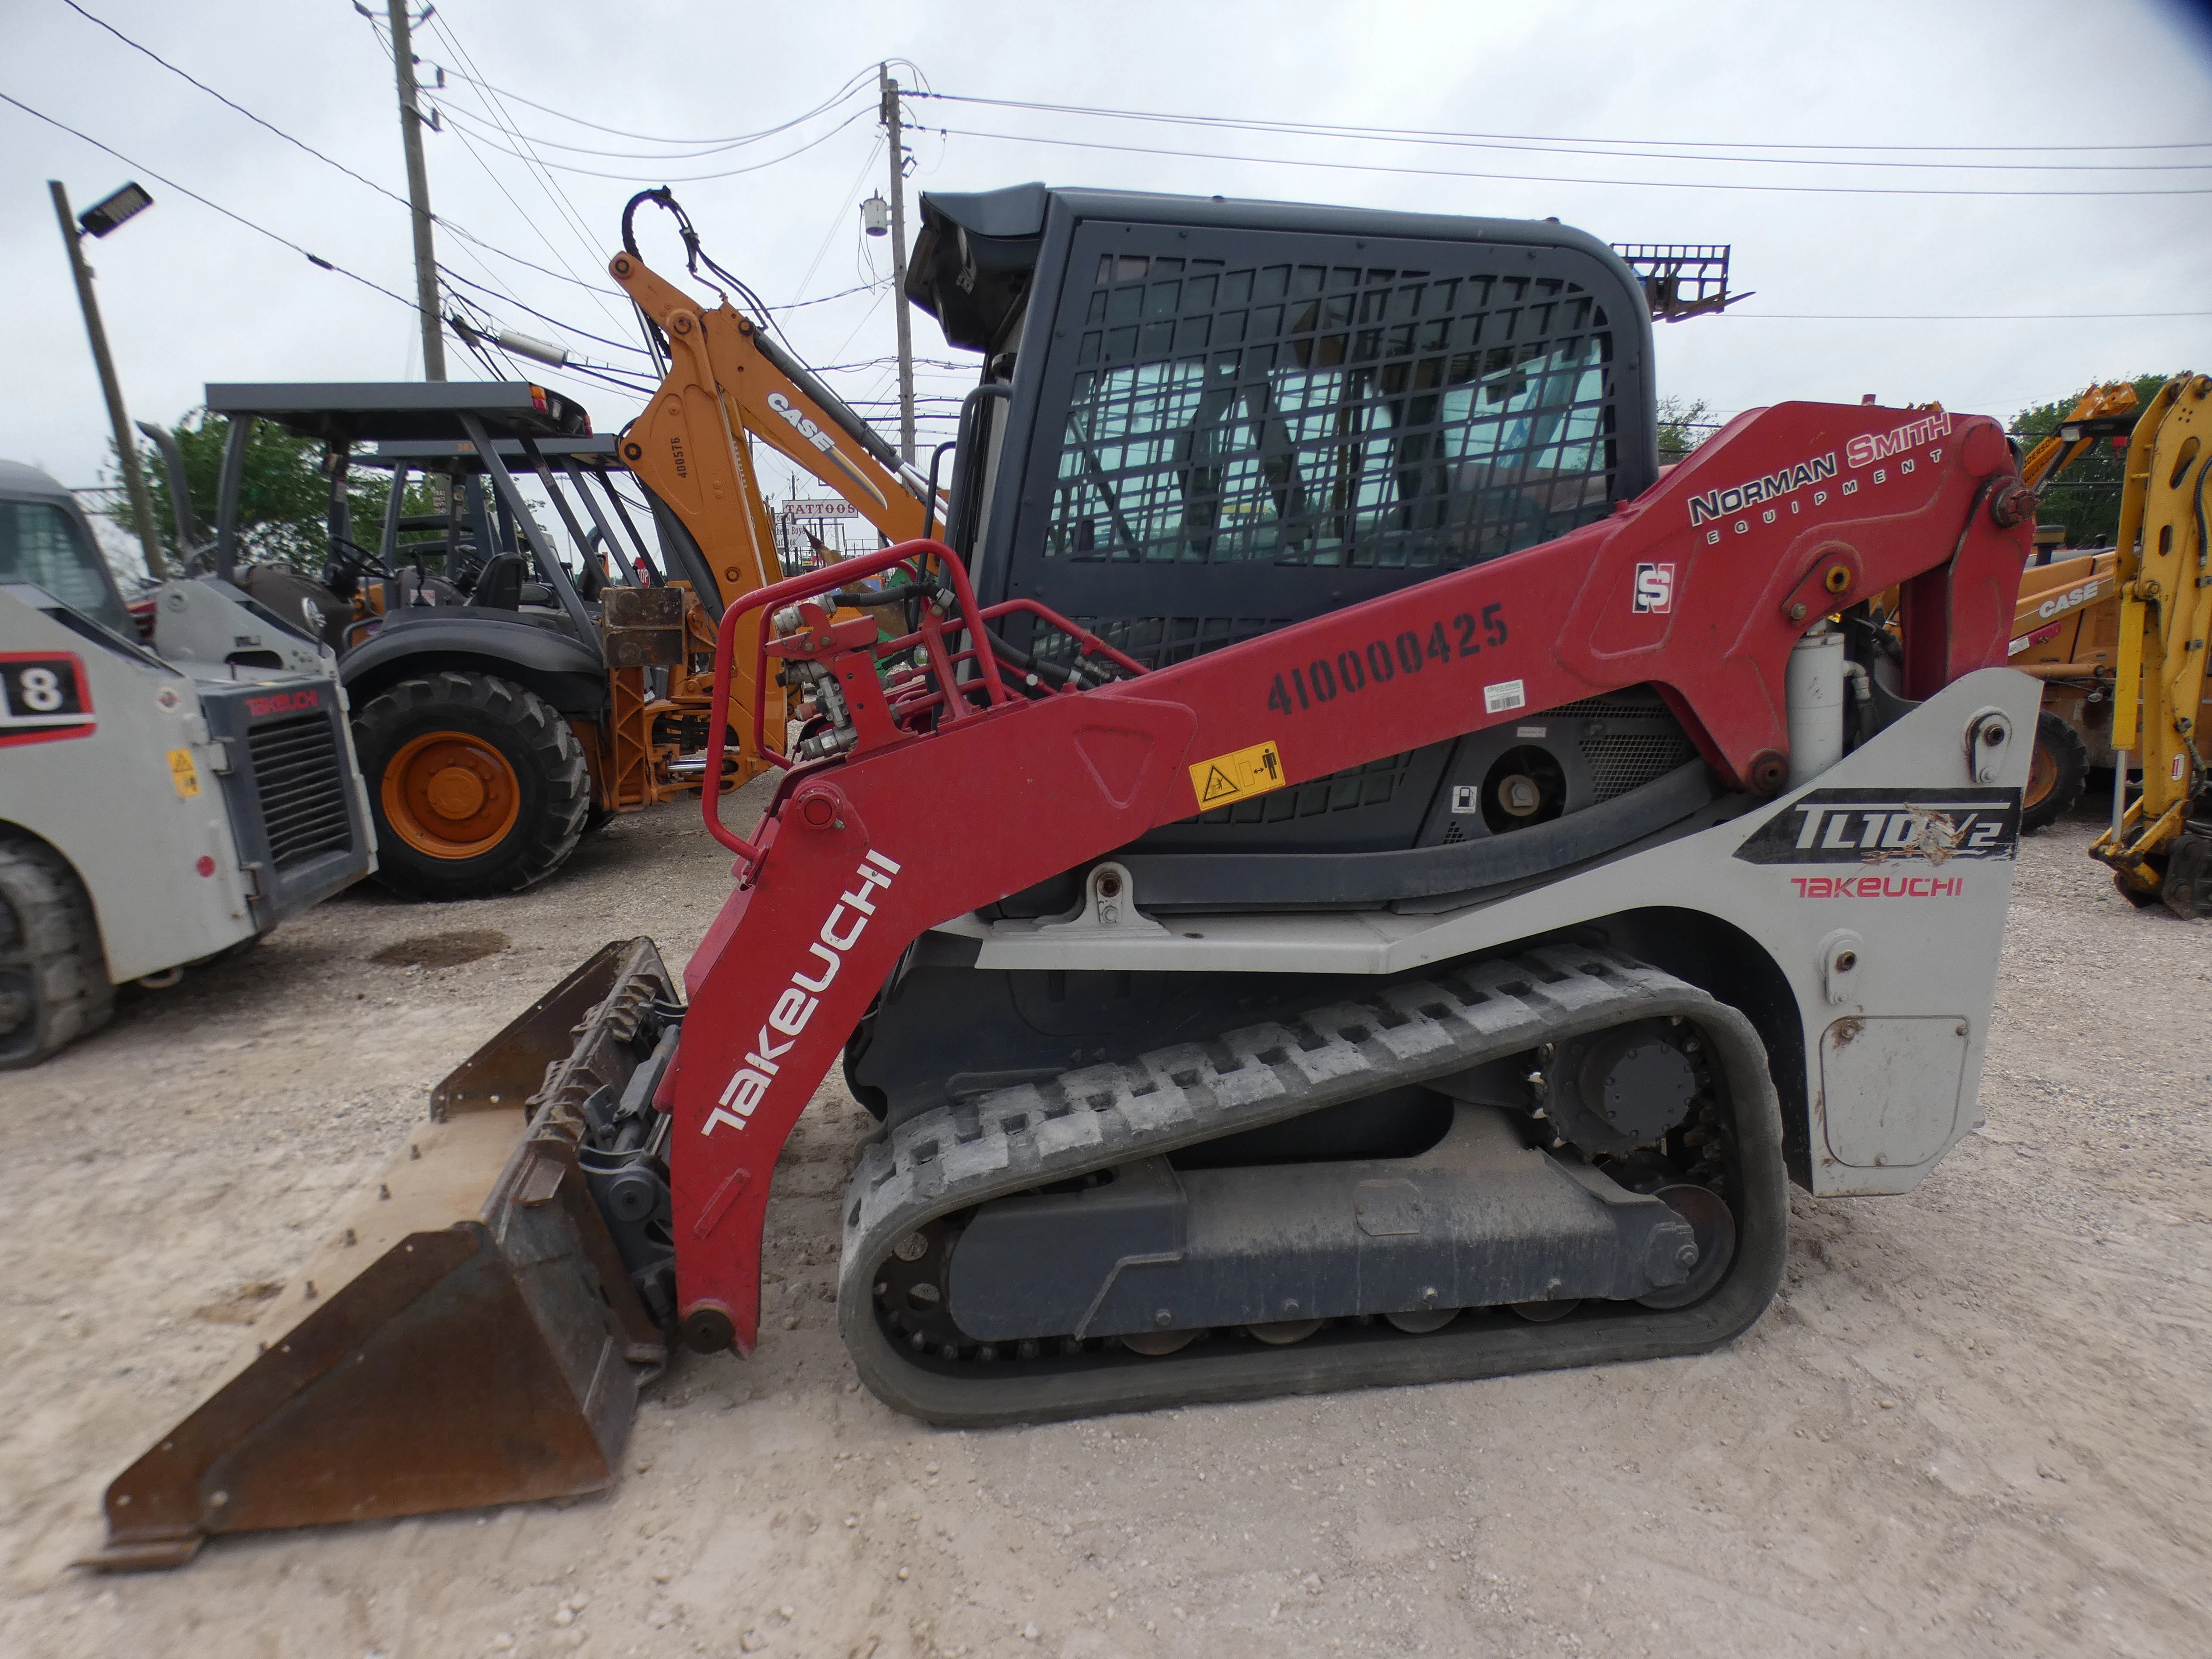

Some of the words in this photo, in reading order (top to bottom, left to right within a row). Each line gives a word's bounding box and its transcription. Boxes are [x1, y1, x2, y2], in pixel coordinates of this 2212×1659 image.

[767, 393, 835, 451] CASE
[670, 437, 687, 478] 400576
[1687, 452, 1837, 527] NORMAN
[1846, 412, 1951, 469] SMITH
[786, 504, 856, 514] TATTOOS
[1706, 449, 1942, 545] EQUIPMENT
[792, 526, 806, 535] Boys
[2038, 581, 2100, 619] CASE
[1266, 602, 1508, 716] 410000425
[1790, 877, 1963, 899] TAKEUCHI
[701, 849, 901, 1137] TAKEUCHI
